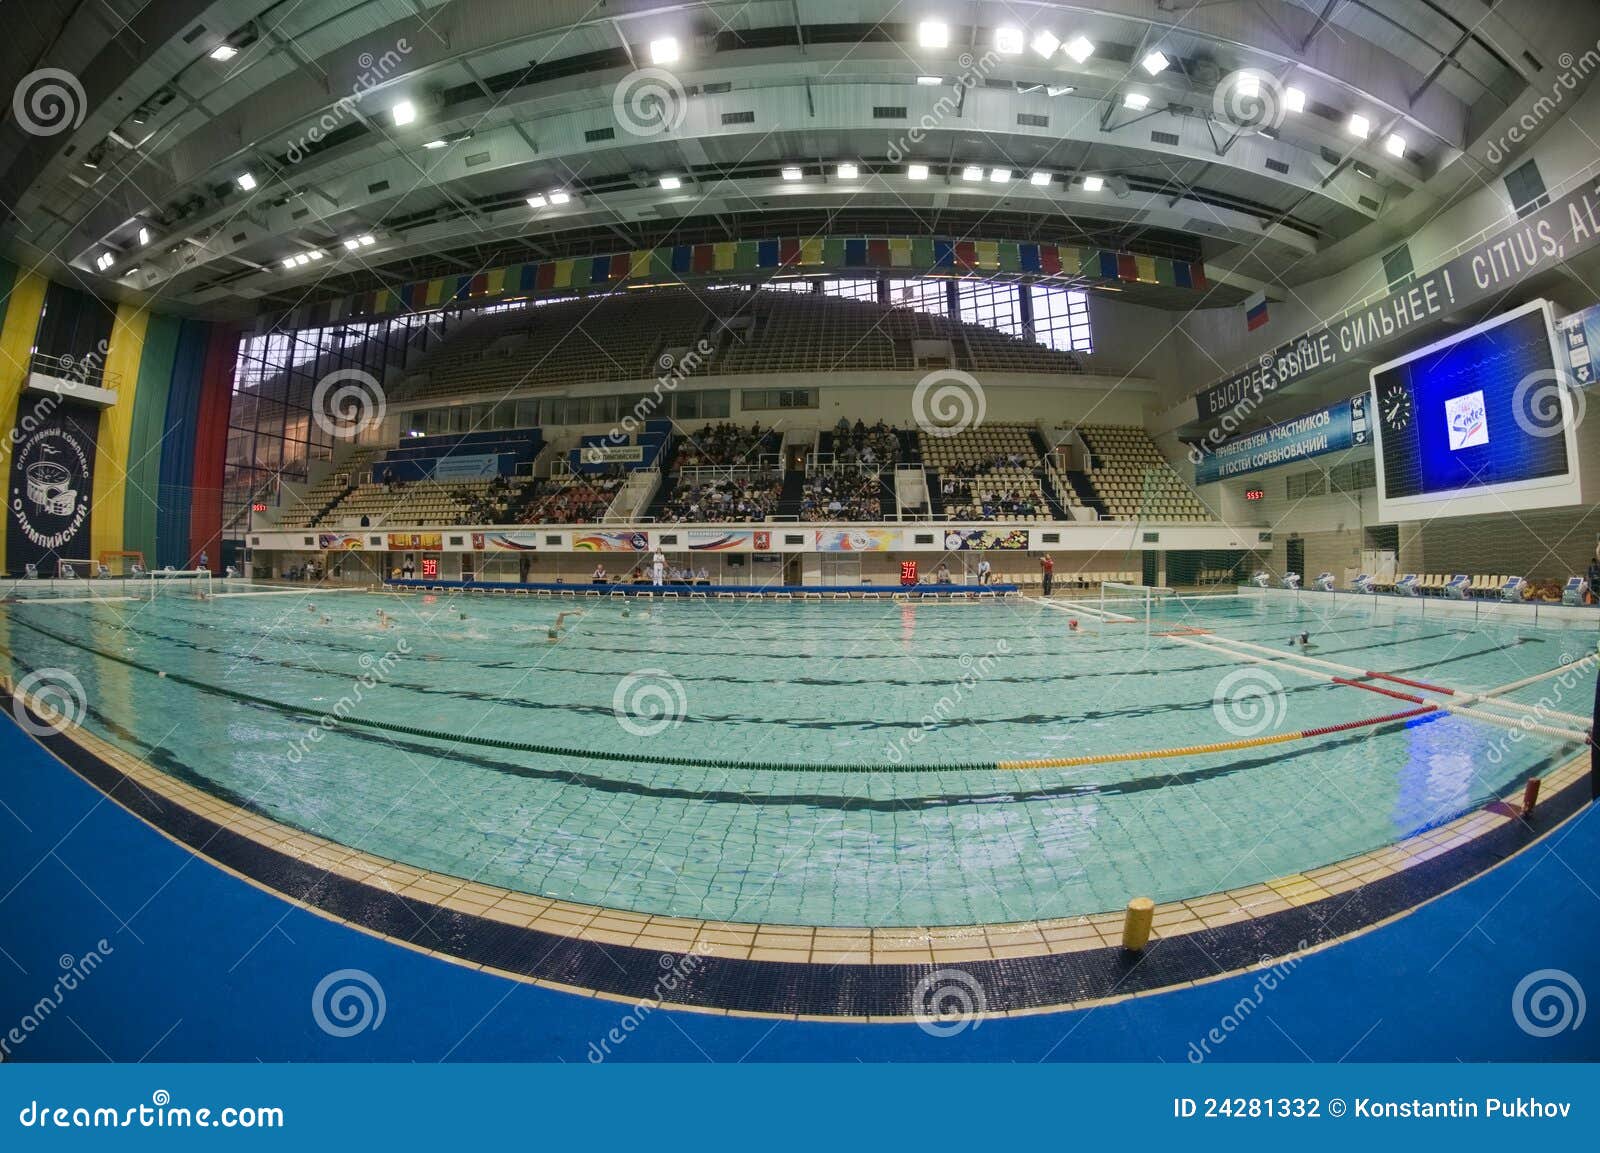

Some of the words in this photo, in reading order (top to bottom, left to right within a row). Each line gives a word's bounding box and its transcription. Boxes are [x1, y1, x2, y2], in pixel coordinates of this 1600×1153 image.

[1279, 335, 1336, 382] ВЫШЕ,
[1472, 220, 1564, 288] CITIUS,
[1568, 186, 1600, 243] AL
[1269, 410, 1330, 442] УЧАСТНИКОВ
[1225, 458, 1251, 474] ГОСТЕЙ
[1252, 432, 1328, 467] СОРЕВНОВАНИЙ!
[13, 498, 87, 549] ОЛИМПИЙСКИЙ
